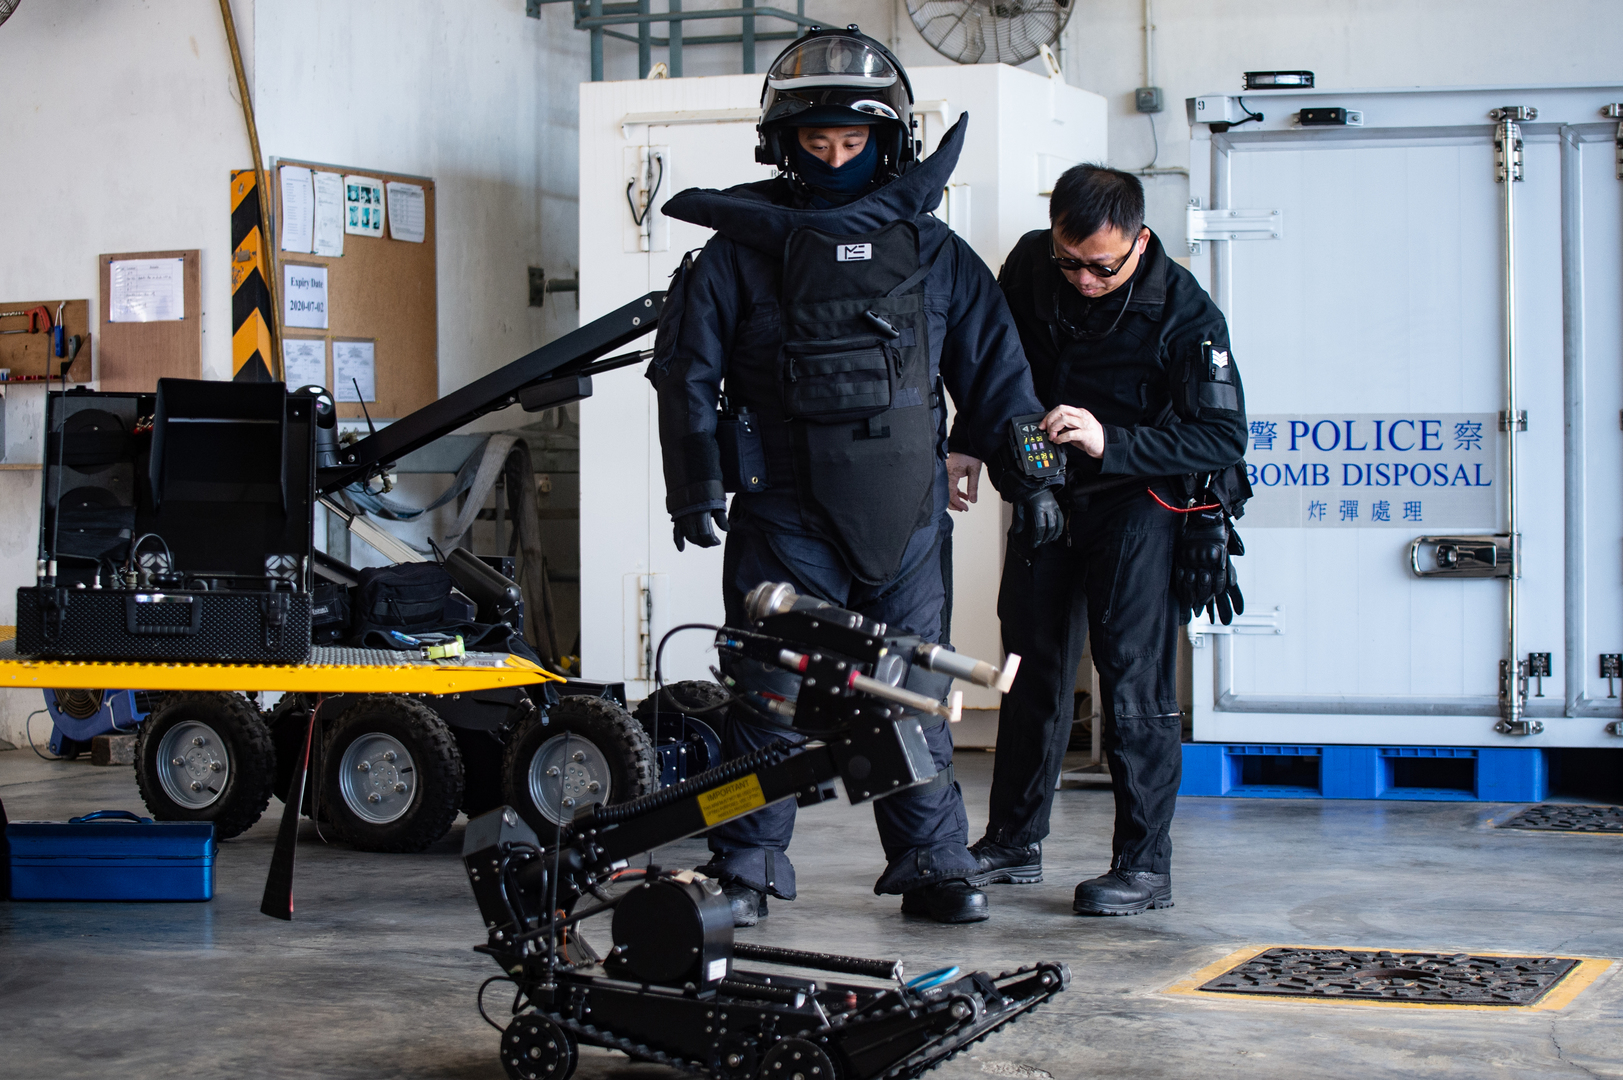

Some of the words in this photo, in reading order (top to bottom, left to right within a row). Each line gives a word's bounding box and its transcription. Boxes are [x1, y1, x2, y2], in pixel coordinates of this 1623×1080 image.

[290, 276, 310, 290] Expiry
[311, 278, 324, 289] Date
[290, 299, 324, 313] 2020-07-02
[1249, 420, 1278, 451] 警
[1287, 419, 1444, 452] POLICE
[1454, 420, 1484, 451] 察
[1342, 463, 1493, 487] DISPOSAL
[1308, 500, 1423, 522] 炸彈處理
[707, 780, 750, 801] IMPORTANT
